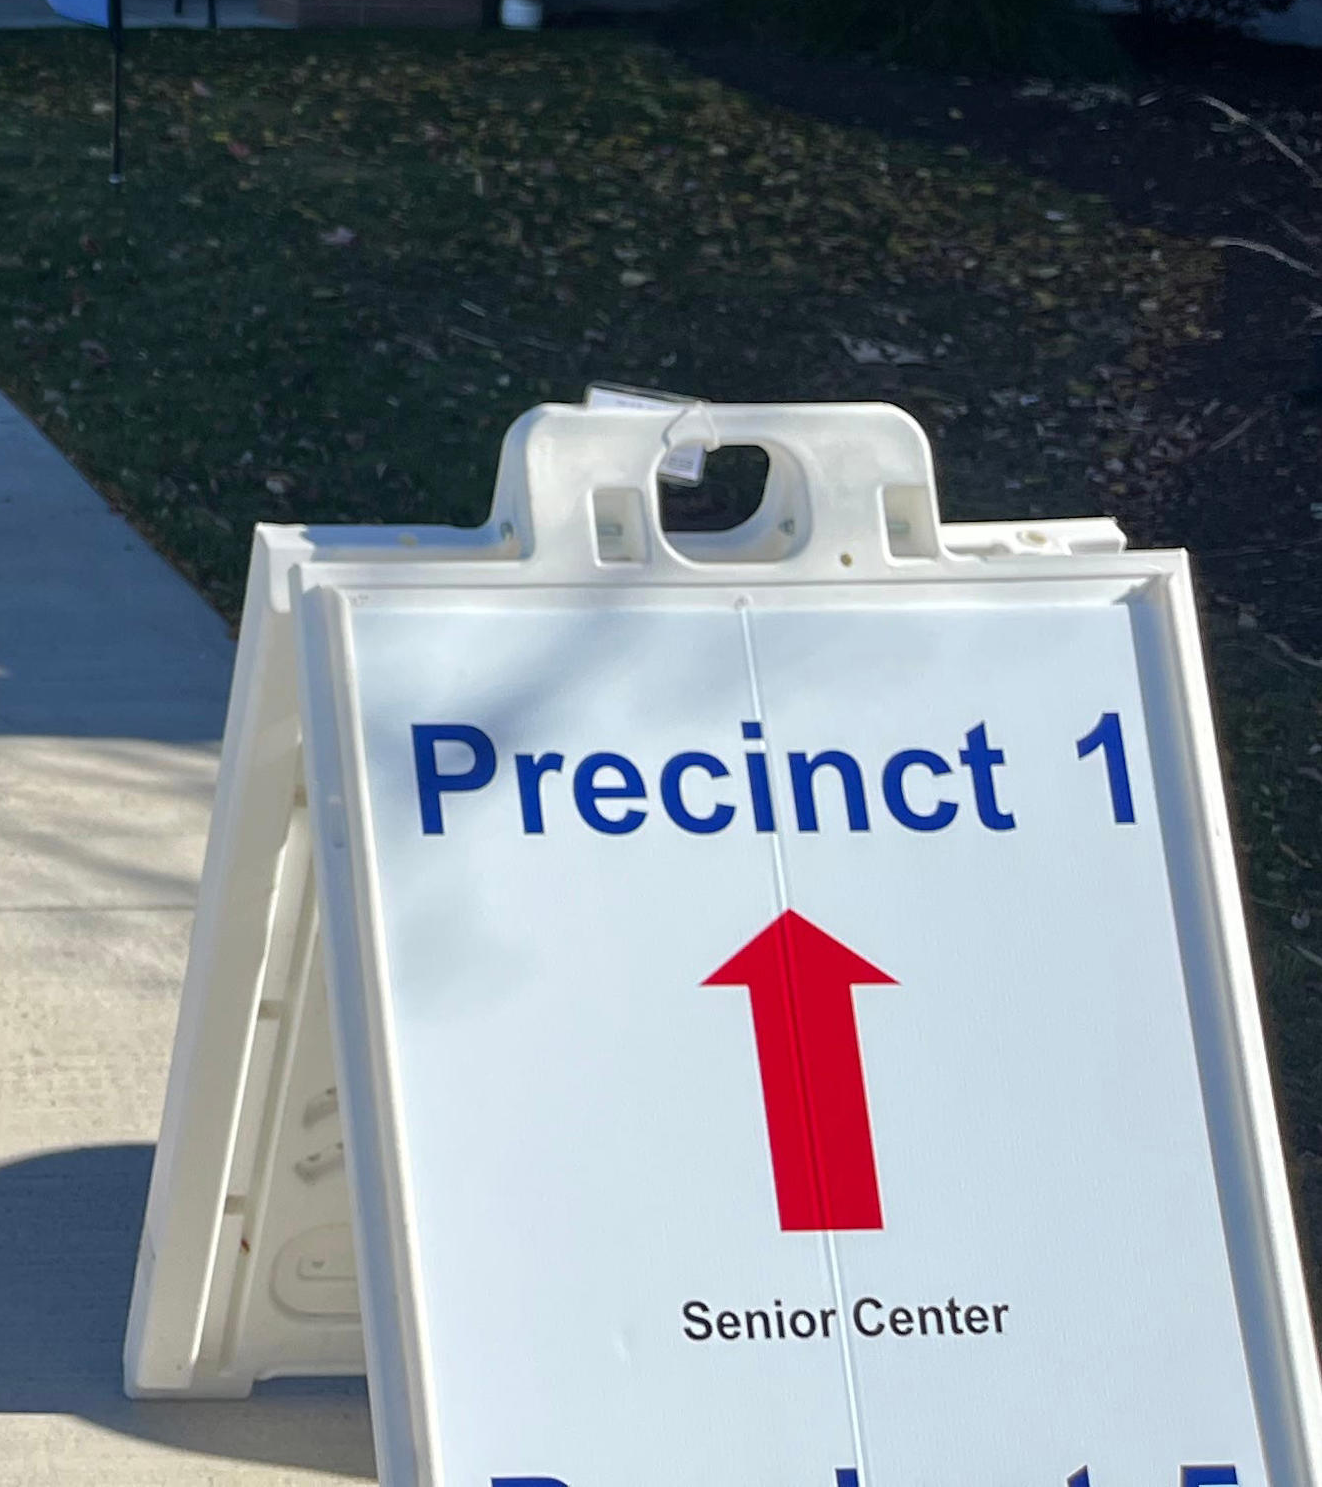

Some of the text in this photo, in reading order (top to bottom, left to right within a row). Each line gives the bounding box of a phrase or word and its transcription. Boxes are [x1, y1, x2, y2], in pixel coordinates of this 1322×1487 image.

[412, 712, 1136, 835] Precinct 1
[683, 1297, 1010, 1340] Senior Center
